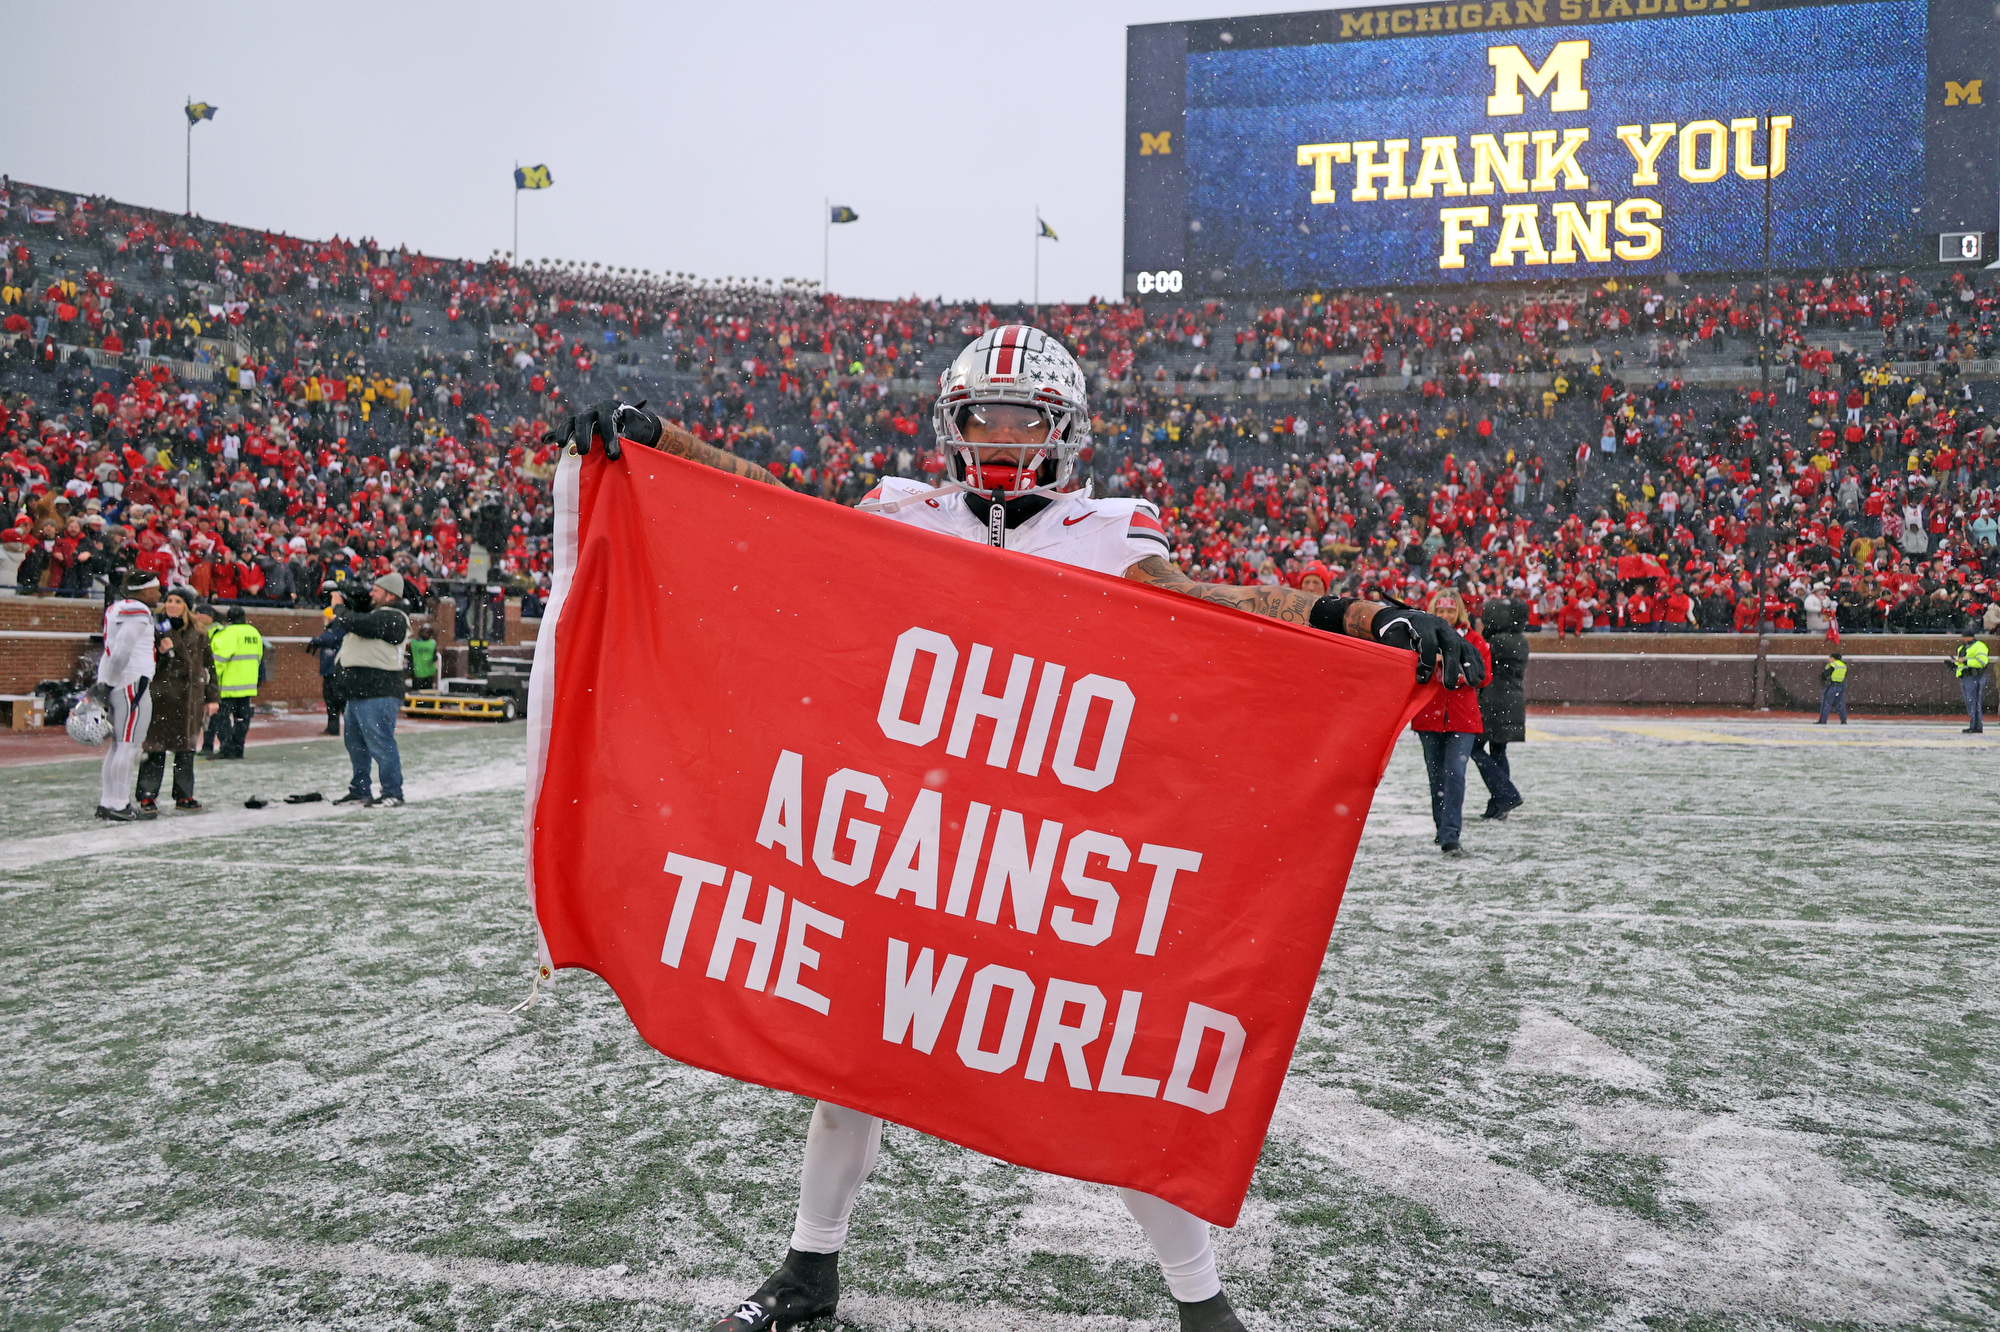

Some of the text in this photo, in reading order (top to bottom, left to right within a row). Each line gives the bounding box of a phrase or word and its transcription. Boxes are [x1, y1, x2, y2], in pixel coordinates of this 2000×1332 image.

[1340, 0, 1546, 37] MICHIGAN
[1487, 39, 1590, 117] M
[1944, 79, 1983, 106] M
[1139, 131, 1172, 156] M
[1296, 115, 1793, 204] THANK YOU
[1438, 198, 1663, 269] FANS
[1961, 235, 1978, 258] 0
[1137, 270, 1183, 294] 0:00
[991, 509, 1002, 548] BATTL
[876, 626, 1136, 793] OHIO
[755, 748, 1204, 957] AGAINST
[660, 851, 1248, 1115] THE WORLD
